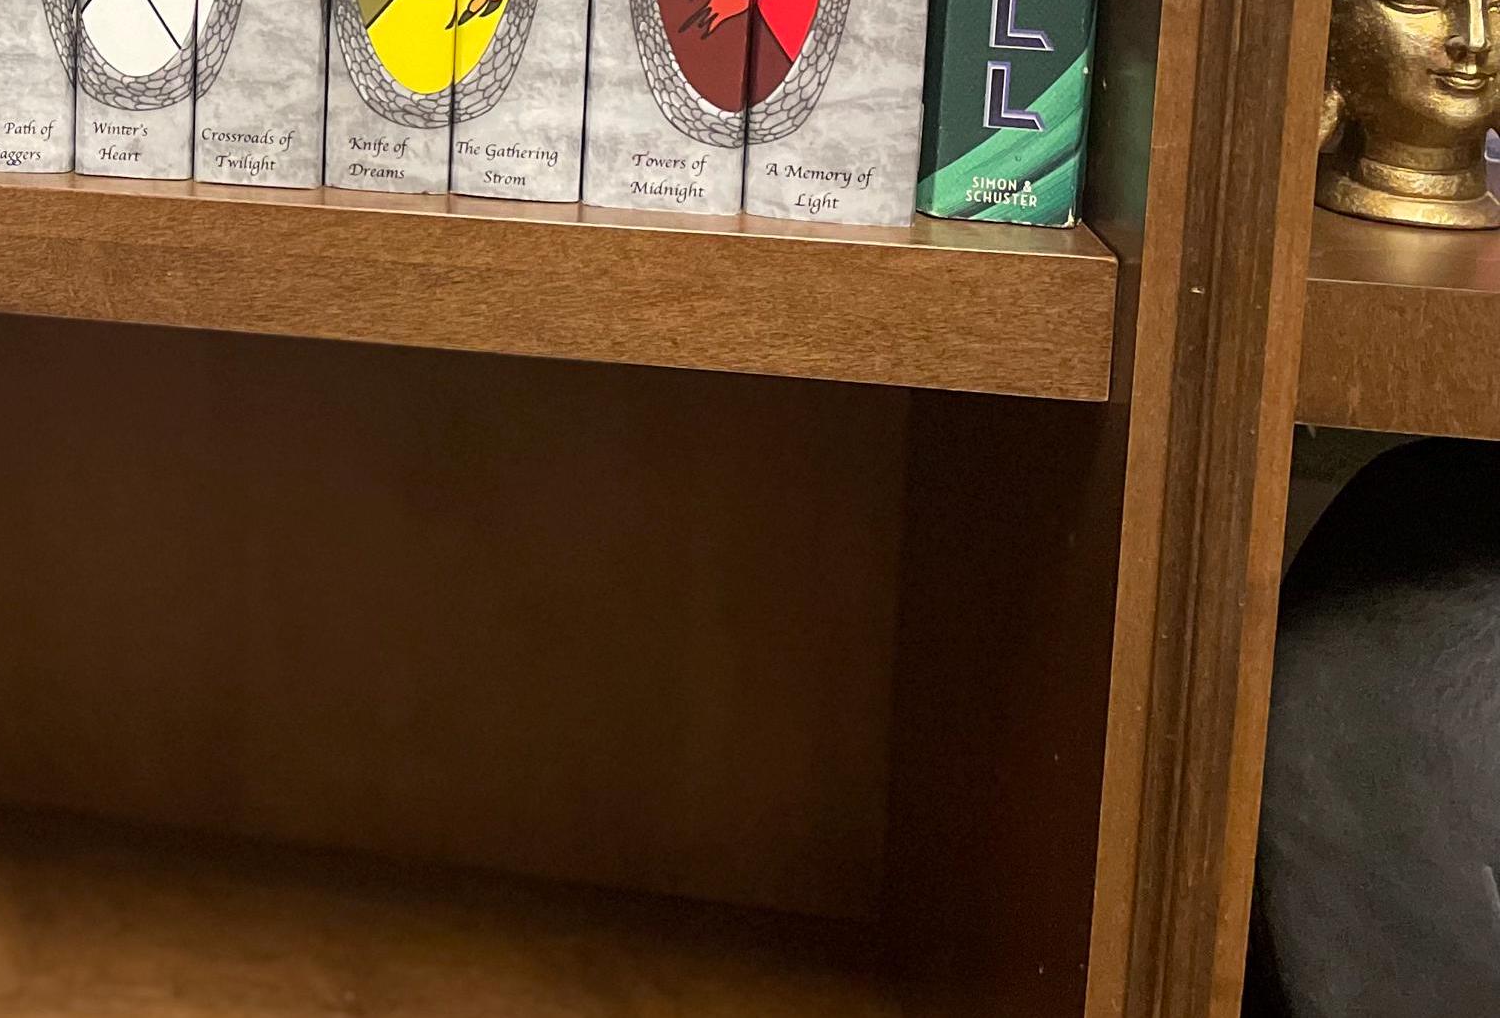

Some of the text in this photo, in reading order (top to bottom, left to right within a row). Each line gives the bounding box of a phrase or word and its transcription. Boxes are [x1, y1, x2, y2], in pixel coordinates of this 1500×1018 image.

[4, 121, 37, 137] Path
[39, 120, 54, 141] of
[92, 121, 149, 138] Winter's
[201, 127, 295, 151] Crossroads of
[98, 147, 141, 163] Heart
[348, 137, 411, 158] Knife of
[455, 140, 559, 166] The Gathering
[215, 154, 276, 176] Twilight
[348, 163, 405, 180] Dreams
[631, 153, 708, 176] Towers of
[483, 170, 526, 187] Strom
[765, 162, 876, 189] A Memory of
[971, 176, 1033, 193] SIMON &
[630, 181, 706, 201] Midnight
[965, 189, 1038, 208] SCHUSTER
[794, 192, 840, 215] Light
